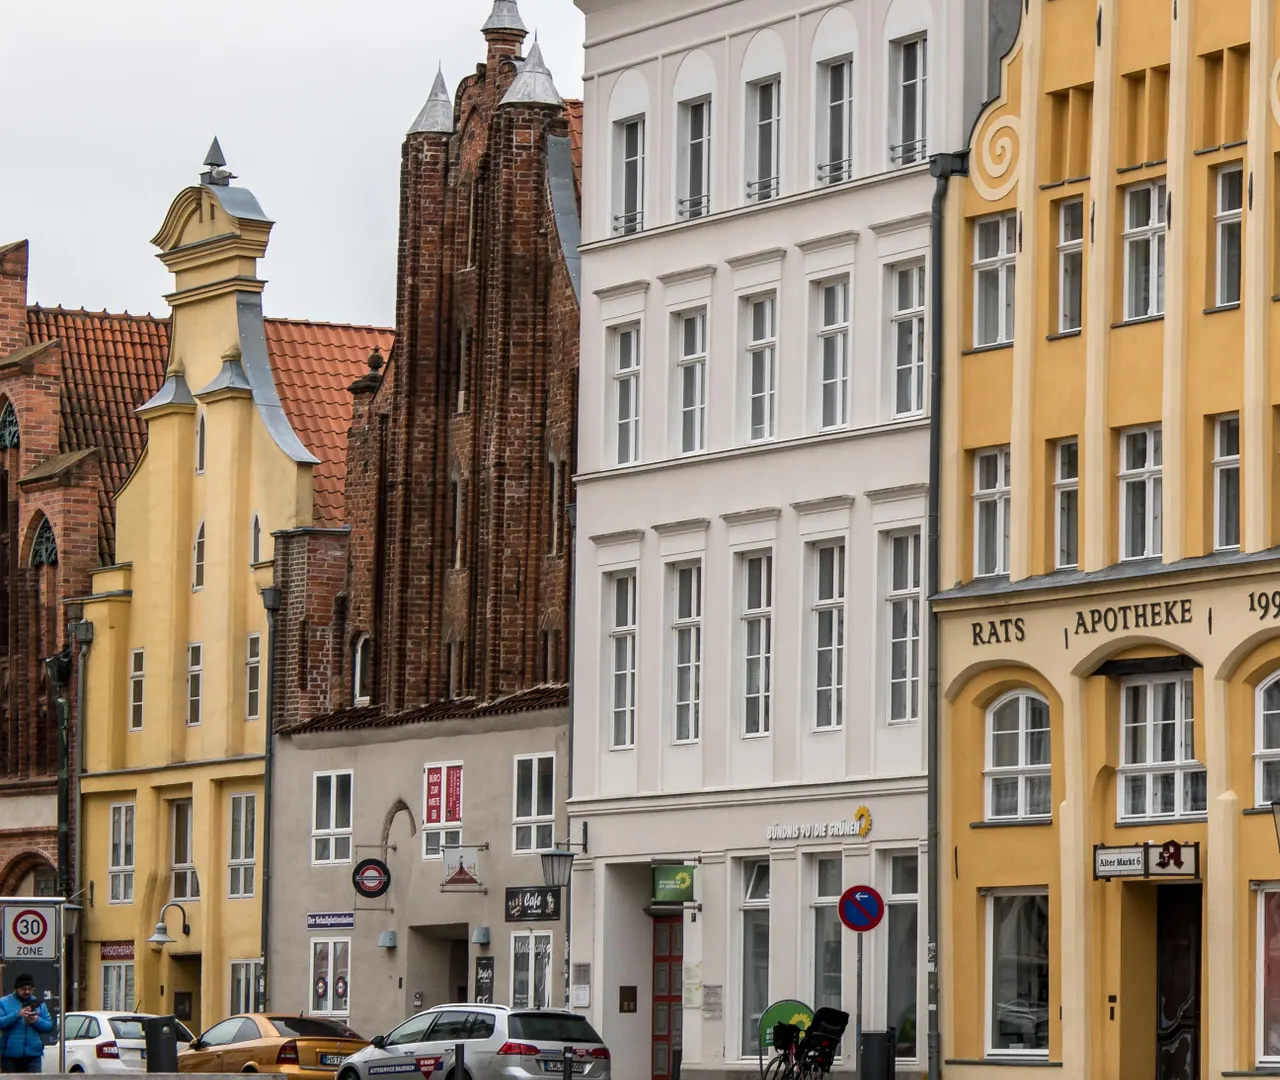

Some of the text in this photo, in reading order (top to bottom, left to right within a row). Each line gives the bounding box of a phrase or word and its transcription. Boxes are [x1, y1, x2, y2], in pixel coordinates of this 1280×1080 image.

[972, 617, 1025, 646] RATS
[1073, 598, 1193, 635] APOTHEKE
[767, 823, 799, 839] BÜNDNIS
[828, 820, 860, 836] GRÜNEN
[1100, 856, 1141, 867] Alter Markt 6
[20, 919, 40, 935] 30
[307, 915, 354, 926] Der Schallplattenladen
[16, 946, 43, 956] ZONE
